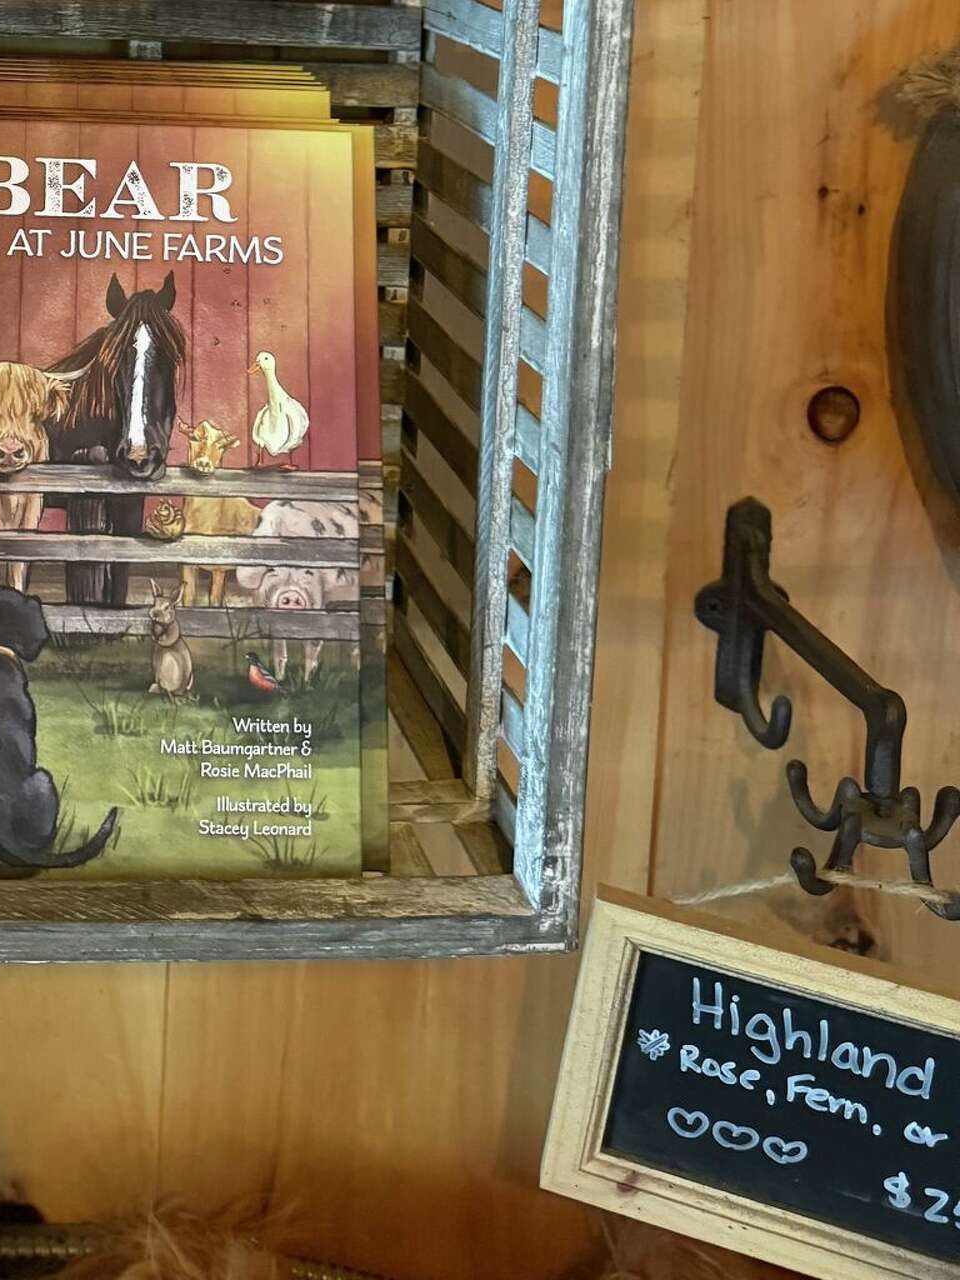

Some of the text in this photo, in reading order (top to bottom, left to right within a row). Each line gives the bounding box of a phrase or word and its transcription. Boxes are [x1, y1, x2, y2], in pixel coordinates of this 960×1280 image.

[6, 228, 285, 266] AT JUNE FARMS
[232, 716, 312, 738] Written by
[160, 739, 312, 760] Matt Baumgartner &
[200, 761, 312, 780] Rosie MacPhail
[216, 795, 312, 818] Illustrated by
[198, 819, 312, 840] Stacey Leonard
[692, 976, 935, 1100] Highland
